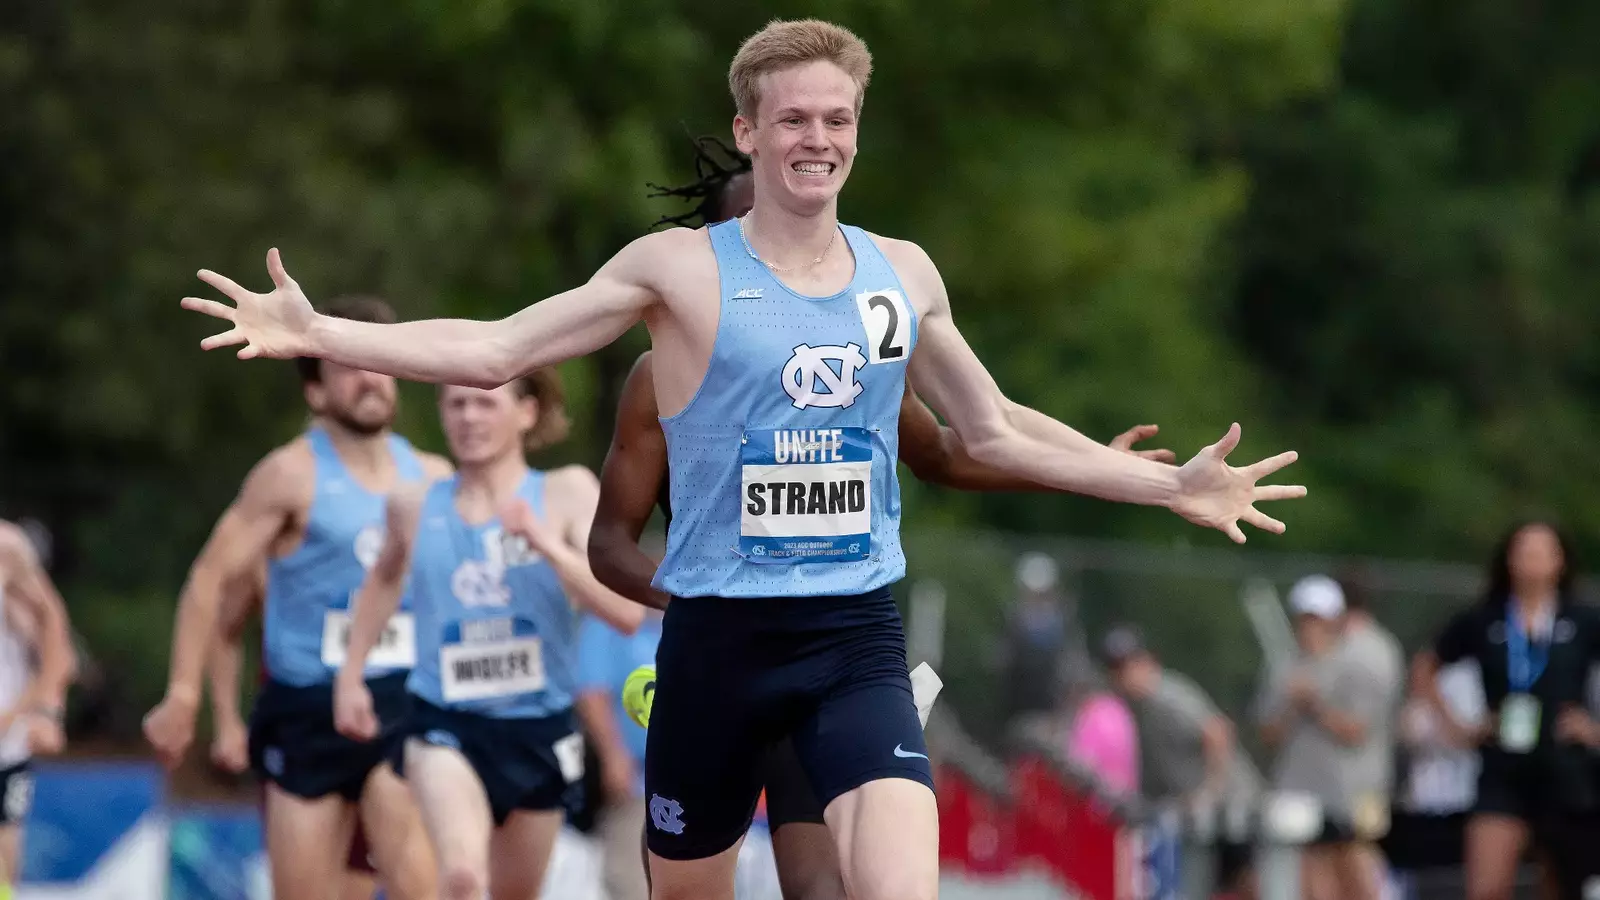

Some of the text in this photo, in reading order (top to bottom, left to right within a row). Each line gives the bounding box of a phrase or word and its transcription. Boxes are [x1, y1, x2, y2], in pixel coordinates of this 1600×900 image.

[733, 288, 764, 298] ACC
[868, 295, 903, 360] 2
[774, 429, 843, 463] UNITE
[747, 480, 866, 516] STRAND
